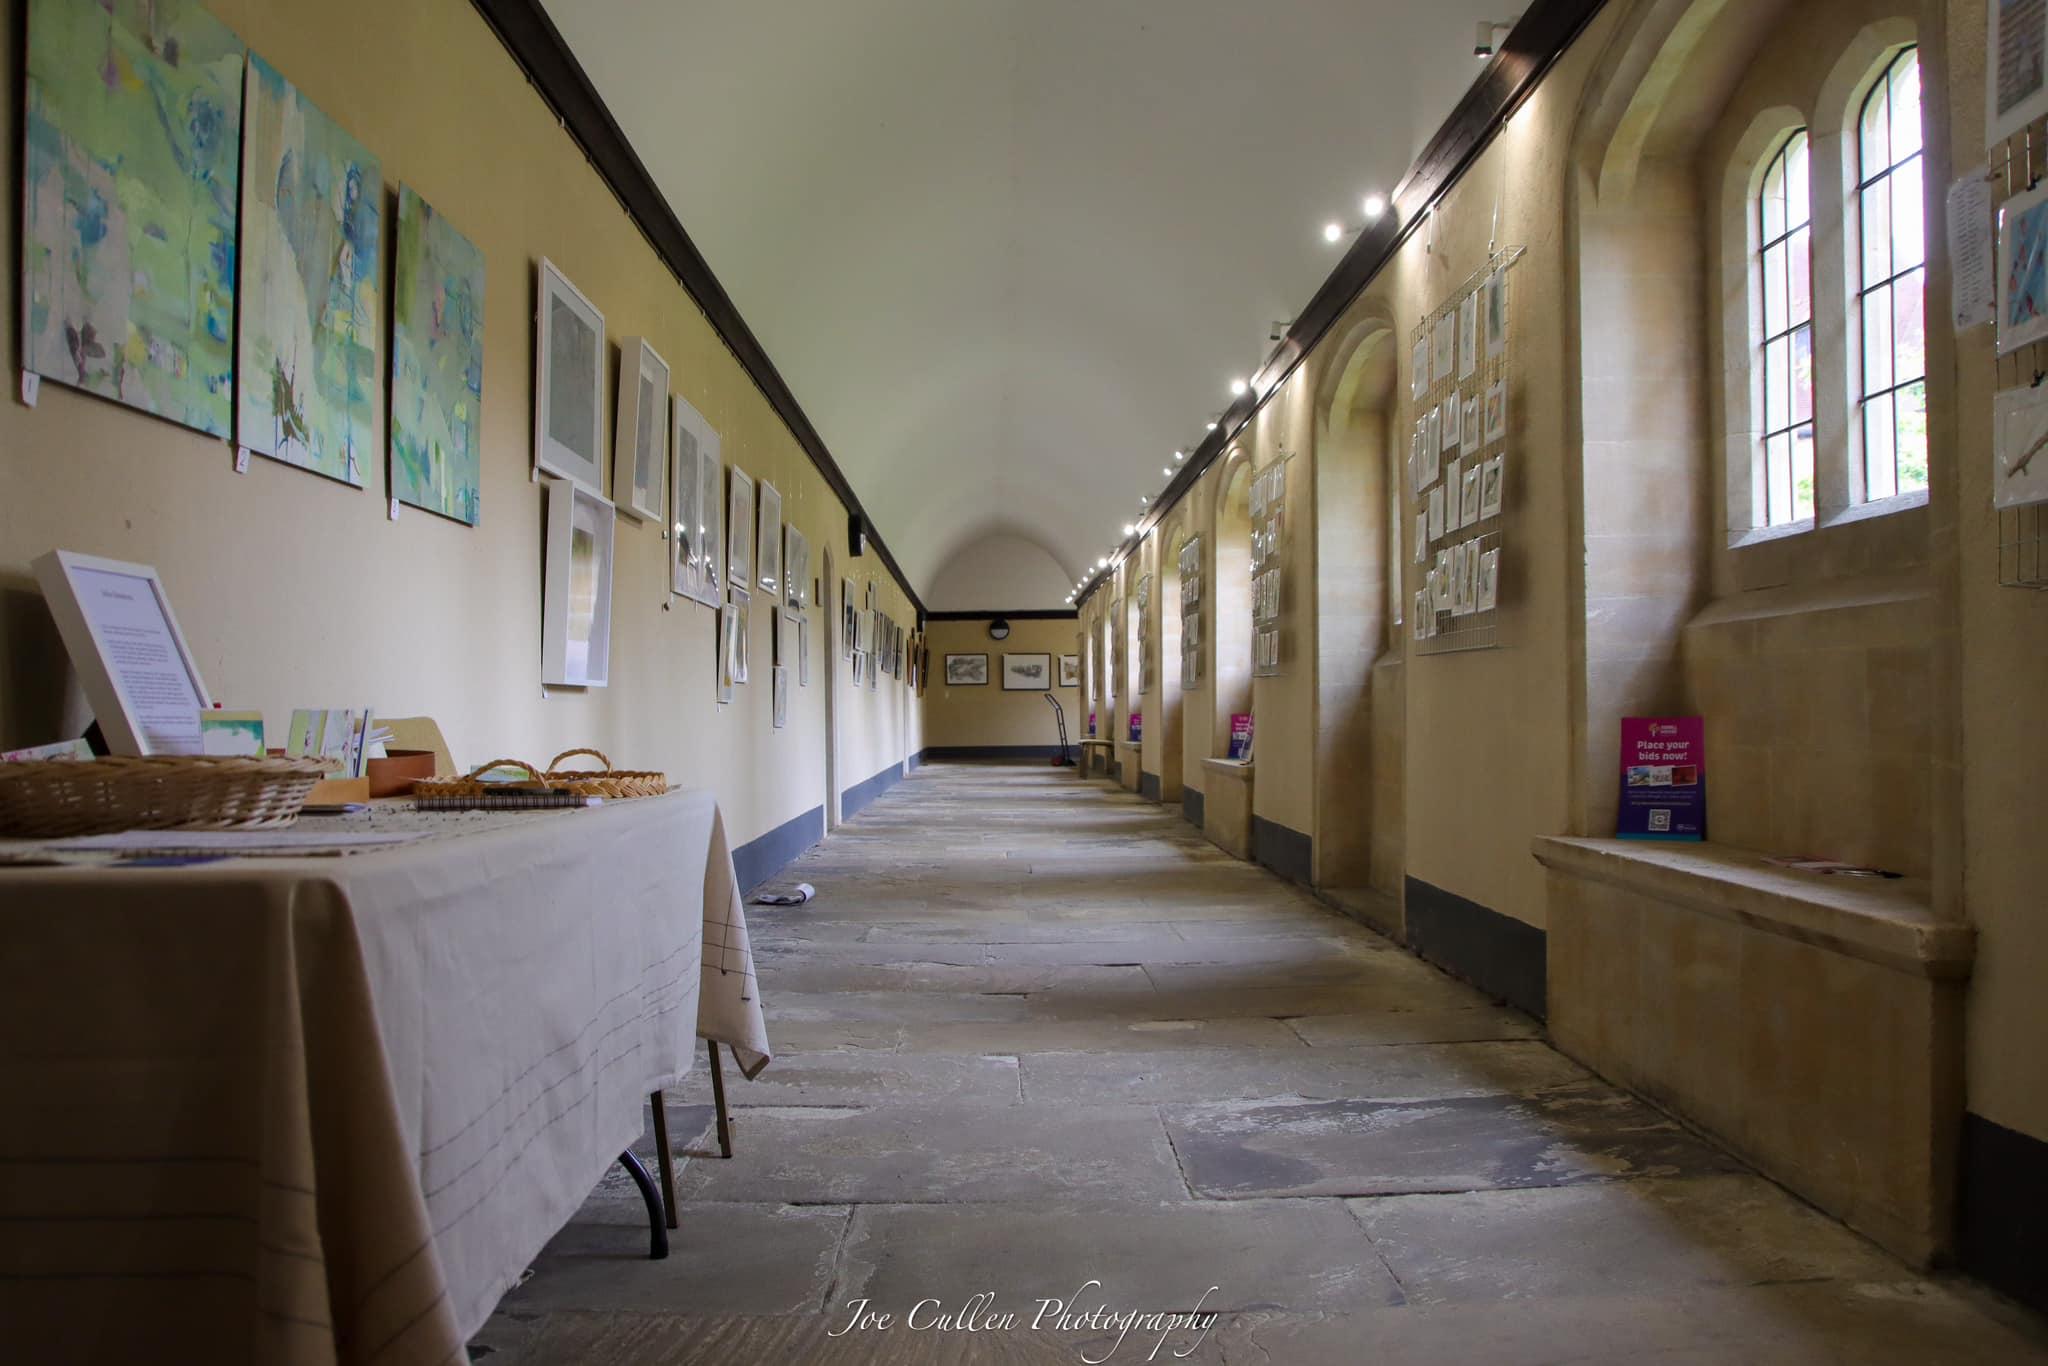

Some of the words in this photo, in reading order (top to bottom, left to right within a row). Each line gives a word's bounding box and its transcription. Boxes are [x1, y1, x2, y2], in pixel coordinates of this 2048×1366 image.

[1637, 741, 1664, 750] Place
[1666, 742, 1689, 752] your
[1638, 752, 1660, 761] bids
[1662, 752, 1687, 761] now!
